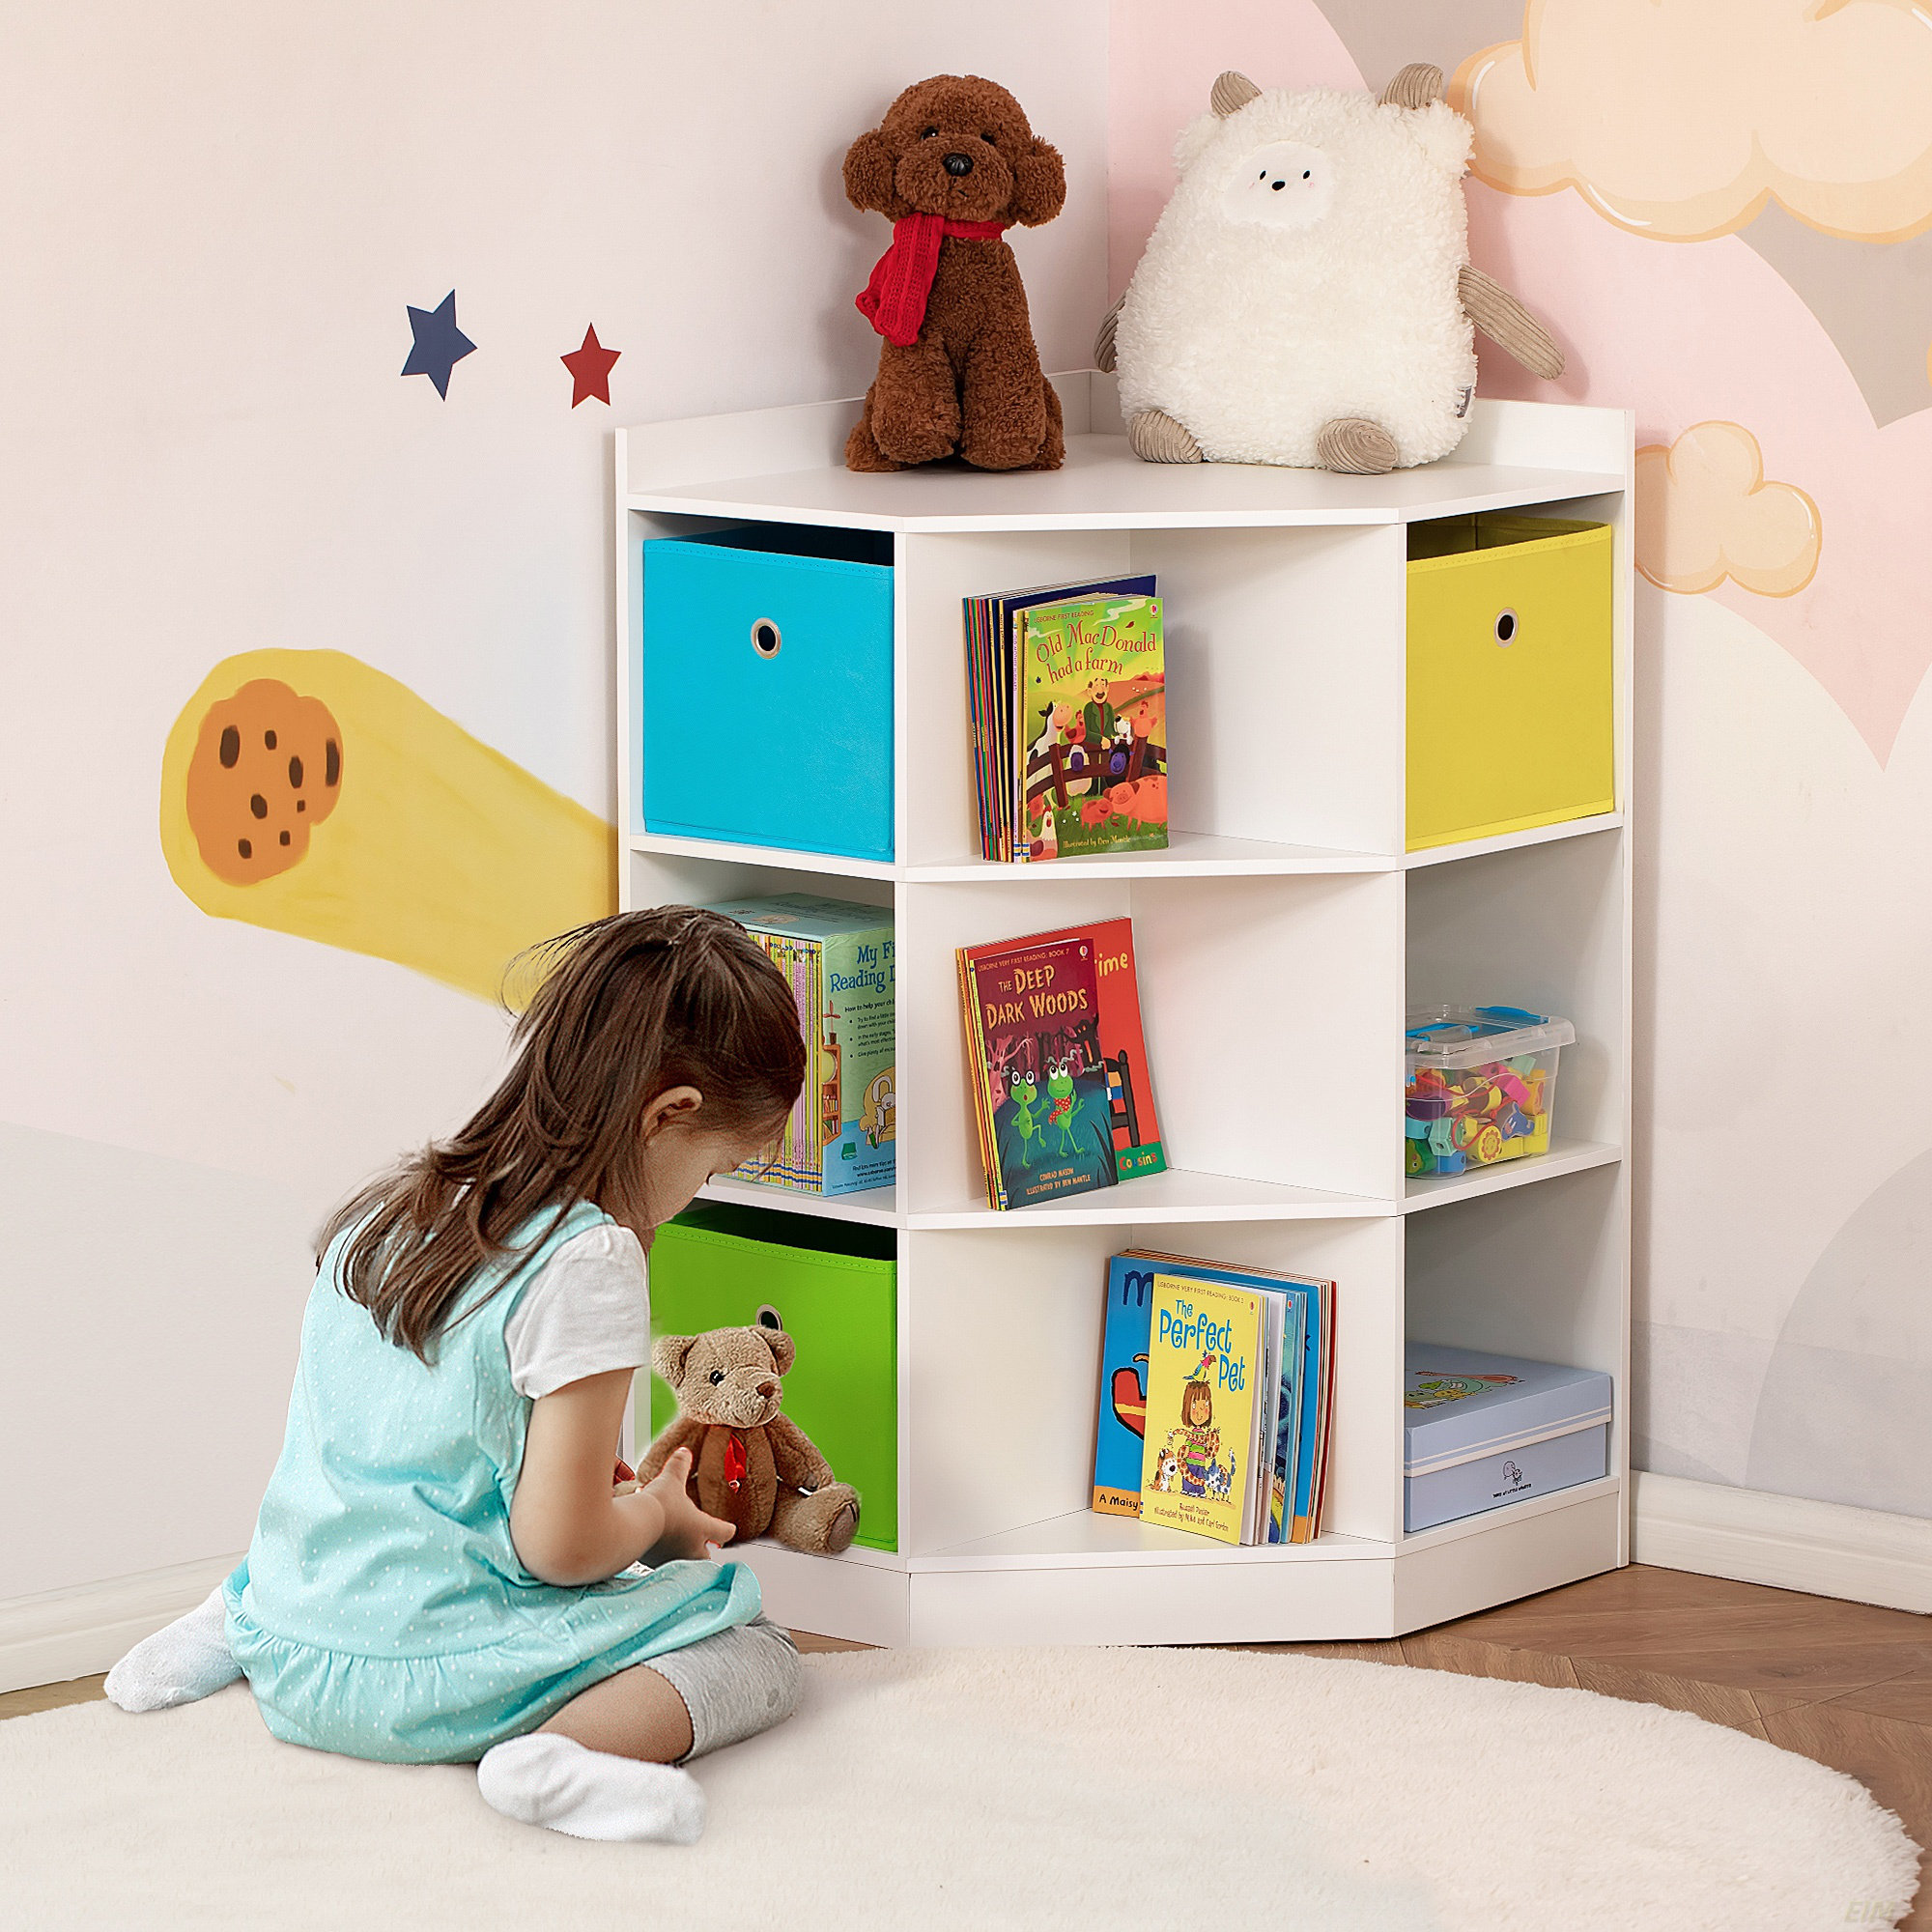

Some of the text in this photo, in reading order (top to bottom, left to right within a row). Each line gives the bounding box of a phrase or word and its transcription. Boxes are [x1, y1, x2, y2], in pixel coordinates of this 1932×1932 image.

[1036, 633, 1063, 662] Old
[1047, 647, 1123, 684] had a farm
[1090, 837, 1097, 847] by
[856, 944, 878, 969] My
[1011, 957, 1023, 965] FIRST
[1049, 949, 1065, 958] BOOK
[829, 969, 886, 994] Reading
[998, 965, 1055, 995] THE DEEP
[985, 988, 1088, 1030] DARK WOODS
[1119, 1151, 1158, 1170] Cousins
[1193, 1287, 1206, 1295] FIRST
[1228, 1294, 1240, 1303] BOOK
[1176, 1299, 1193, 1319] The
[1160, 1308, 1232, 1353] Perfect
[1219, 1354, 1246, 1392] Pet
[1099, 1493, 1138, 1511] A Maisy
[1179, 1512, 1184, 1522] by
